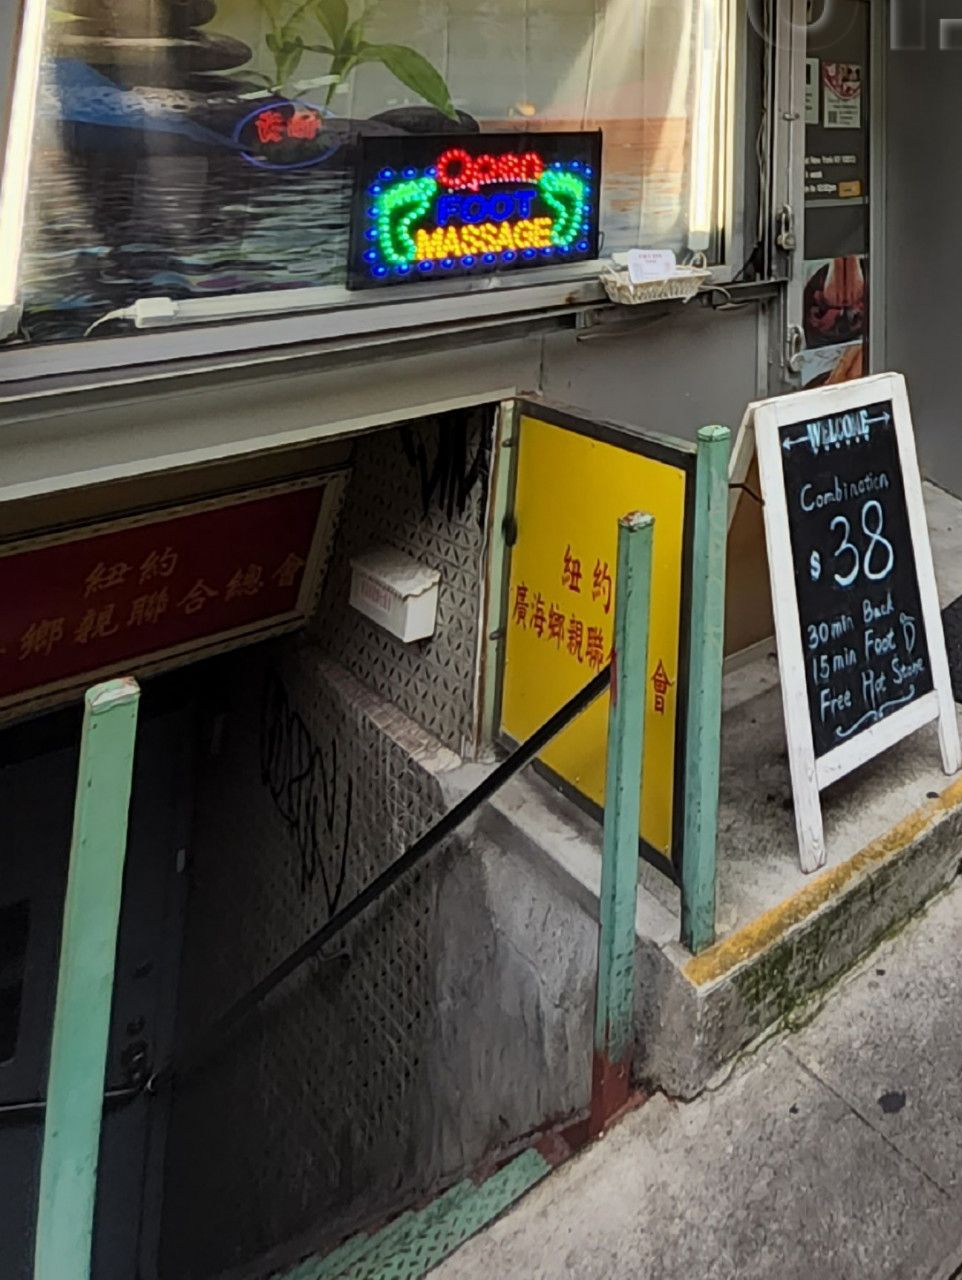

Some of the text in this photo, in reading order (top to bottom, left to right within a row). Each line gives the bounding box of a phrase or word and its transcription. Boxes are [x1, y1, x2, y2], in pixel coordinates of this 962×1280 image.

[436, 189, 538, 226] FOOT
[415, 217, 554, 261] MASSAGE
[807, 409, 870, 450] WELCOME
[800, 472, 890, 512] Combination
[82, 545, 179, 601] 紐約
[561, 543, 613, 615] 紐約
[0, 552, 306, 662] 鄉親聯合總會
[864, 627, 896, 662] Foot
[819, 687, 852, 724] Free
[861, 669, 887, 709] Hot
